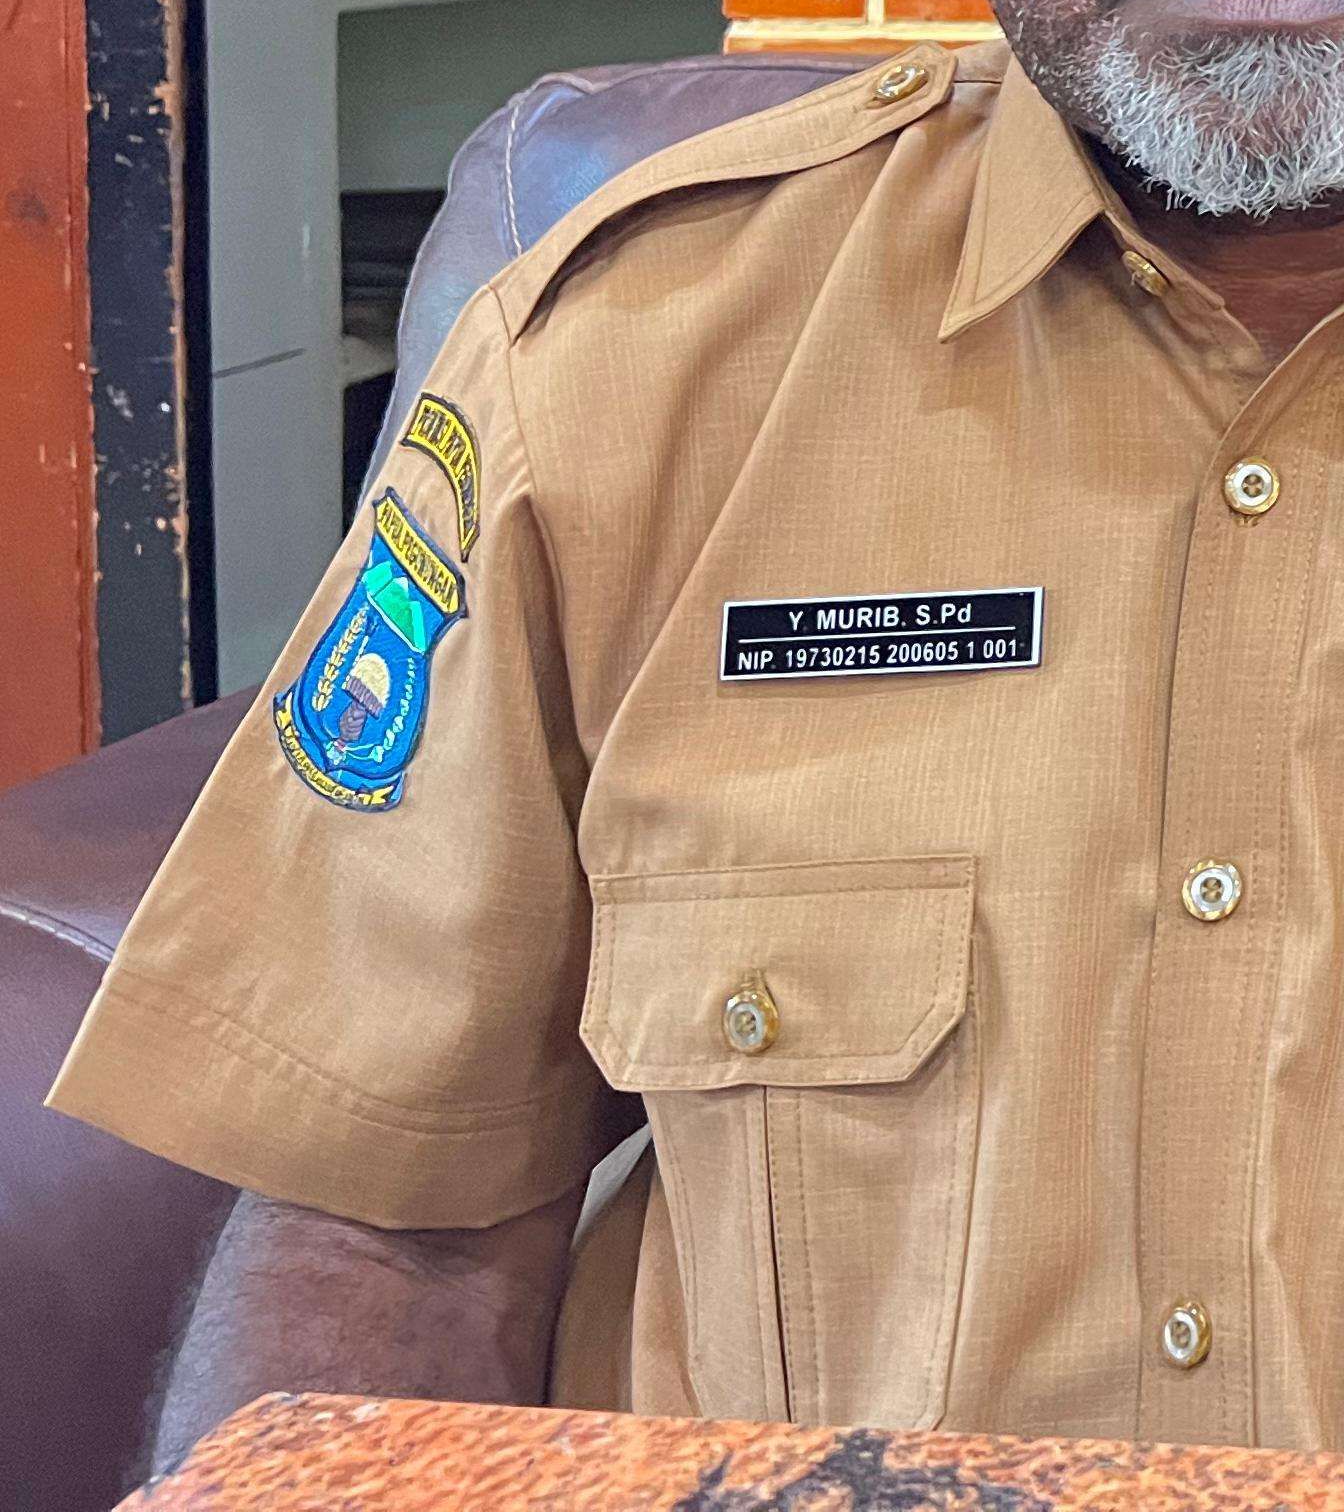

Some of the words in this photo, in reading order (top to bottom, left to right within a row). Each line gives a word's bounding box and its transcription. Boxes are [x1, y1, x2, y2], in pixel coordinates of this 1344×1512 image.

[816, 606, 907, 631] MURIB.
[915, 603, 973, 626] S.Pd
[785, 644, 881, 669] 19730215
[886, 641, 959, 664] 200605
[967, 640, 975, 659] 1
[983, 638, 1017, 659] 001
